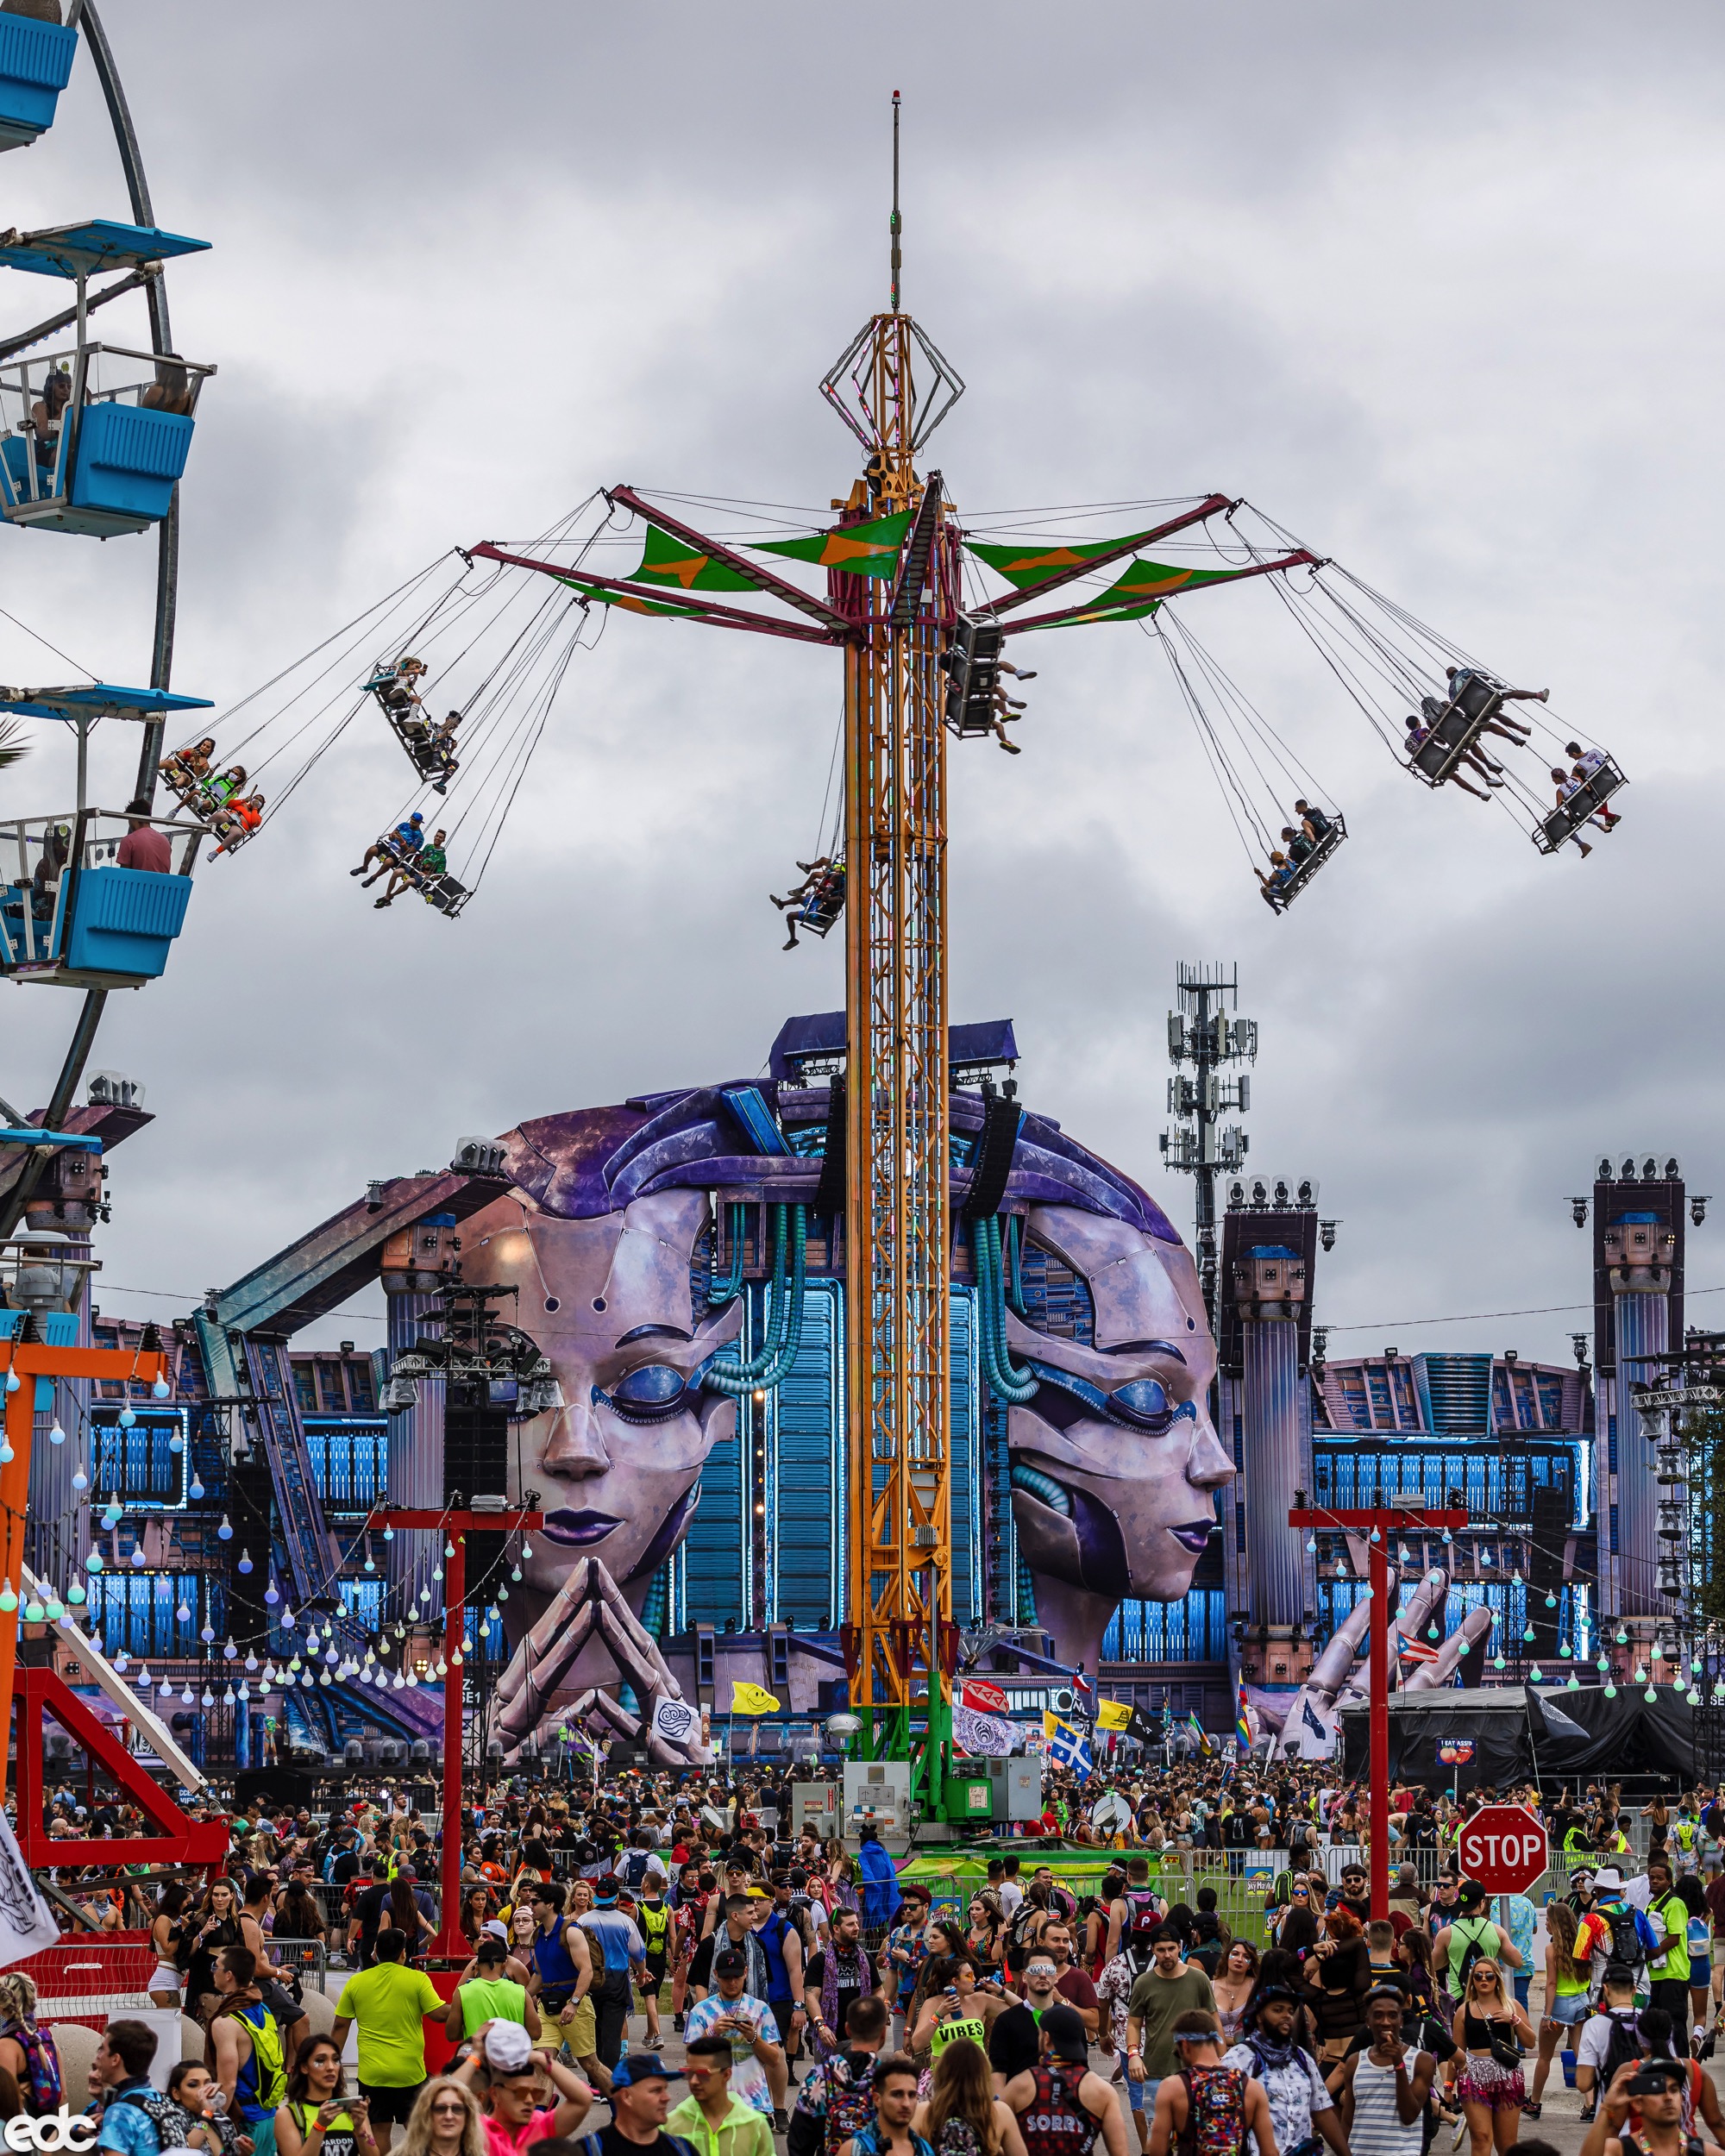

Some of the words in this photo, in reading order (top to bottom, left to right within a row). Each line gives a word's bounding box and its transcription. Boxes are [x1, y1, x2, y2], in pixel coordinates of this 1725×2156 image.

[1465, 1834, 1541, 1868] STOP
[938, 2021, 983, 2042] VIBES
[1026, 2114, 1084, 2134] SORRY
[321, 2137, 354, 2147] PARDON
[324, 2144, 354, 2156] MY
